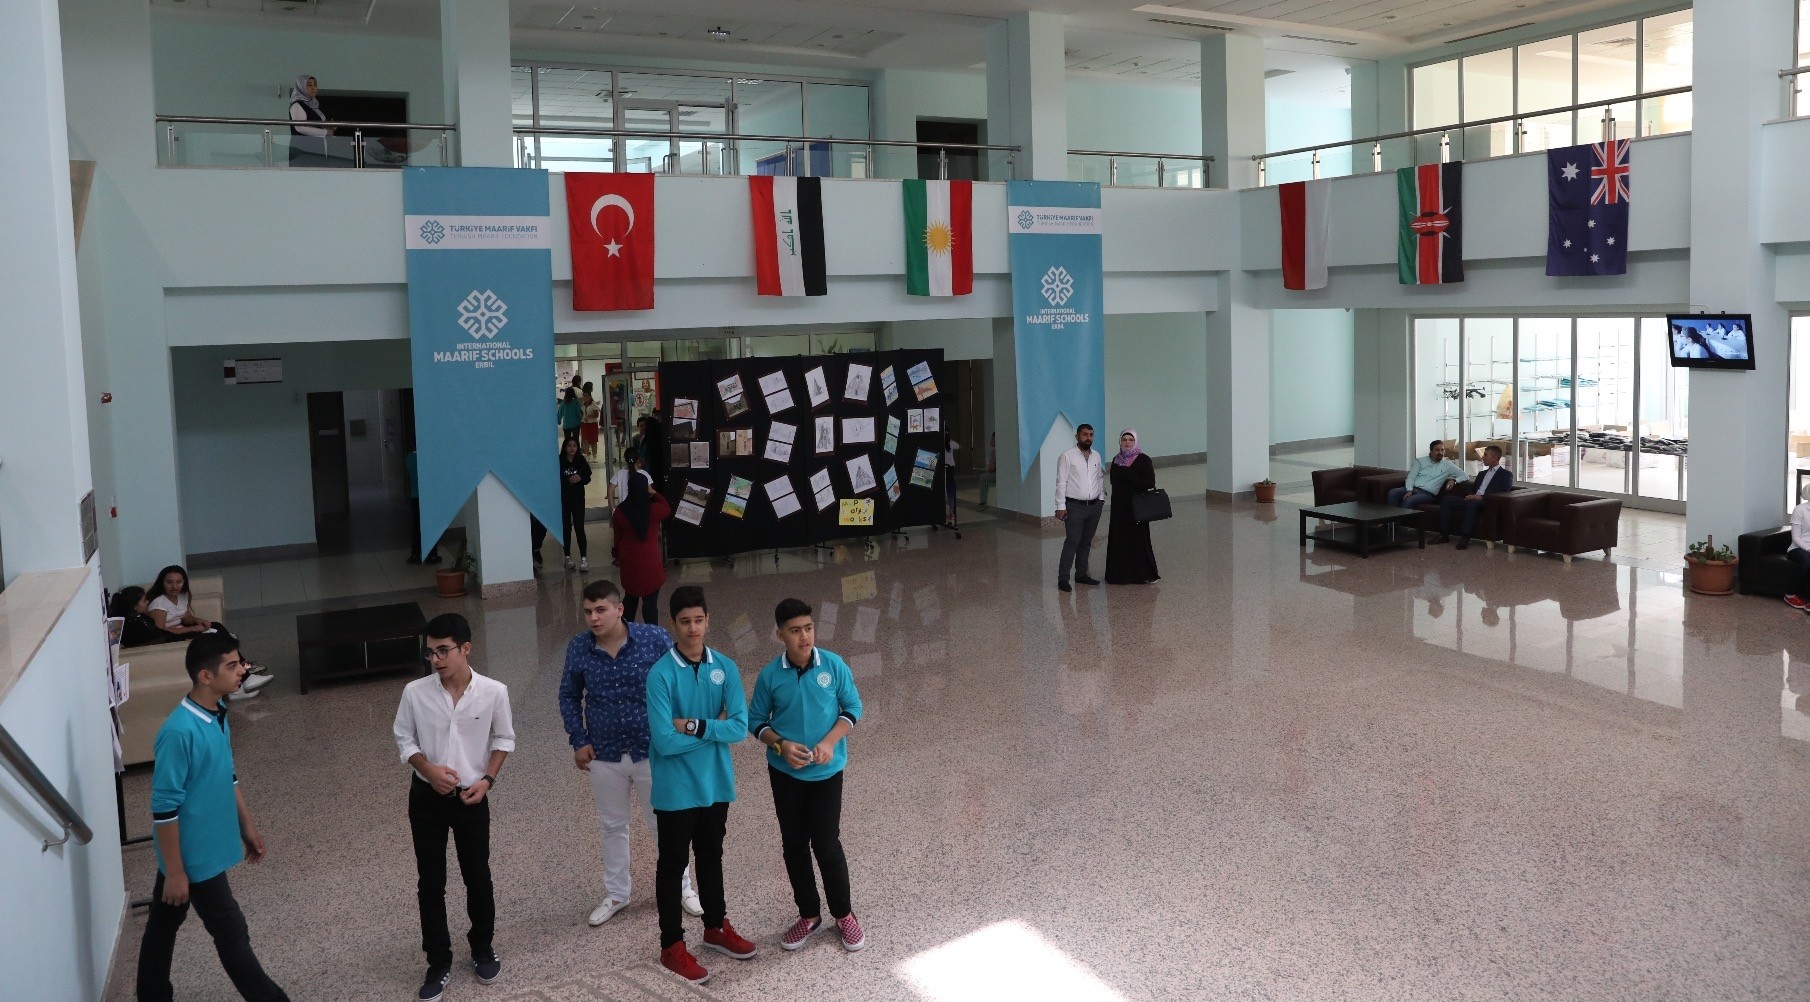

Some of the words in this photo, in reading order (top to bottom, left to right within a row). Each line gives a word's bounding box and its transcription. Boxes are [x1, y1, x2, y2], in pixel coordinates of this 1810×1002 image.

[515, 225, 538, 233] VAKFI
[1026, 314, 1055, 324] MAARIF
[1056, 313, 1090, 323] SCHOOLS
[456, 341, 511, 350] INTERNATIONAL
[433, 350, 480, 362] MAARIF
[481, 348, 534, 361] SCHOOLS
